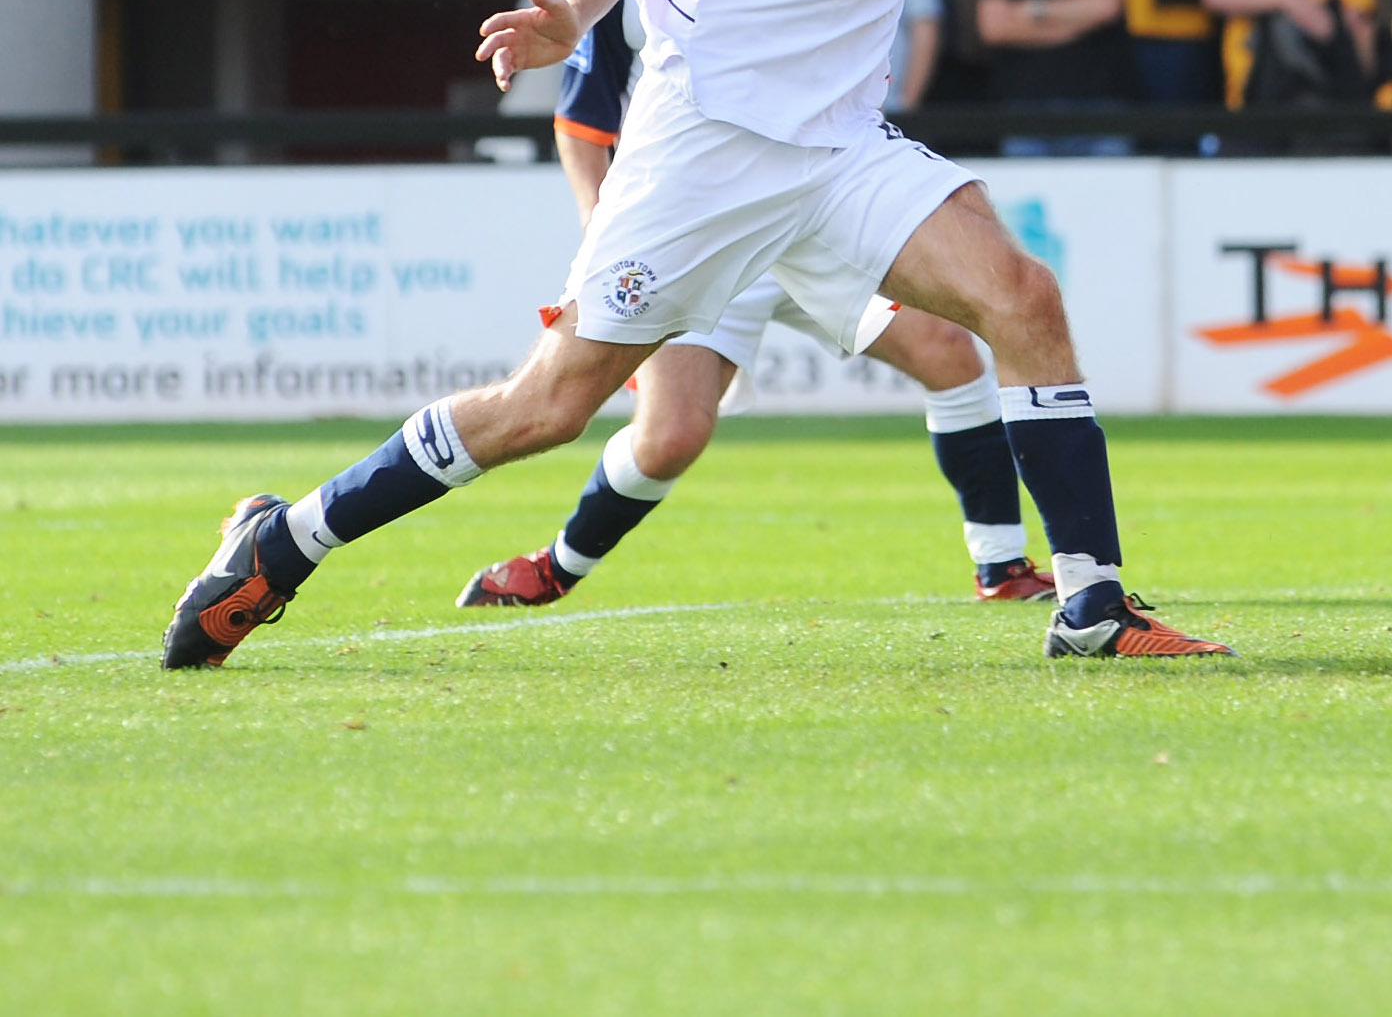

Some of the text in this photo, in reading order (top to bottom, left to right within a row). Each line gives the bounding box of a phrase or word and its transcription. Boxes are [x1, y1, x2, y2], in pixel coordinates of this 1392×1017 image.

[176, 216, 252, 253] you
[272, 211, 380, 246] want
[12, 253, 471, 297] do CRC will help you
[610, 260, 658, 282] LUTON TOWN
[134, 307, 228, 343] your
[246, 300, 366, 343] goals
[52, 364, 183, 399] more
